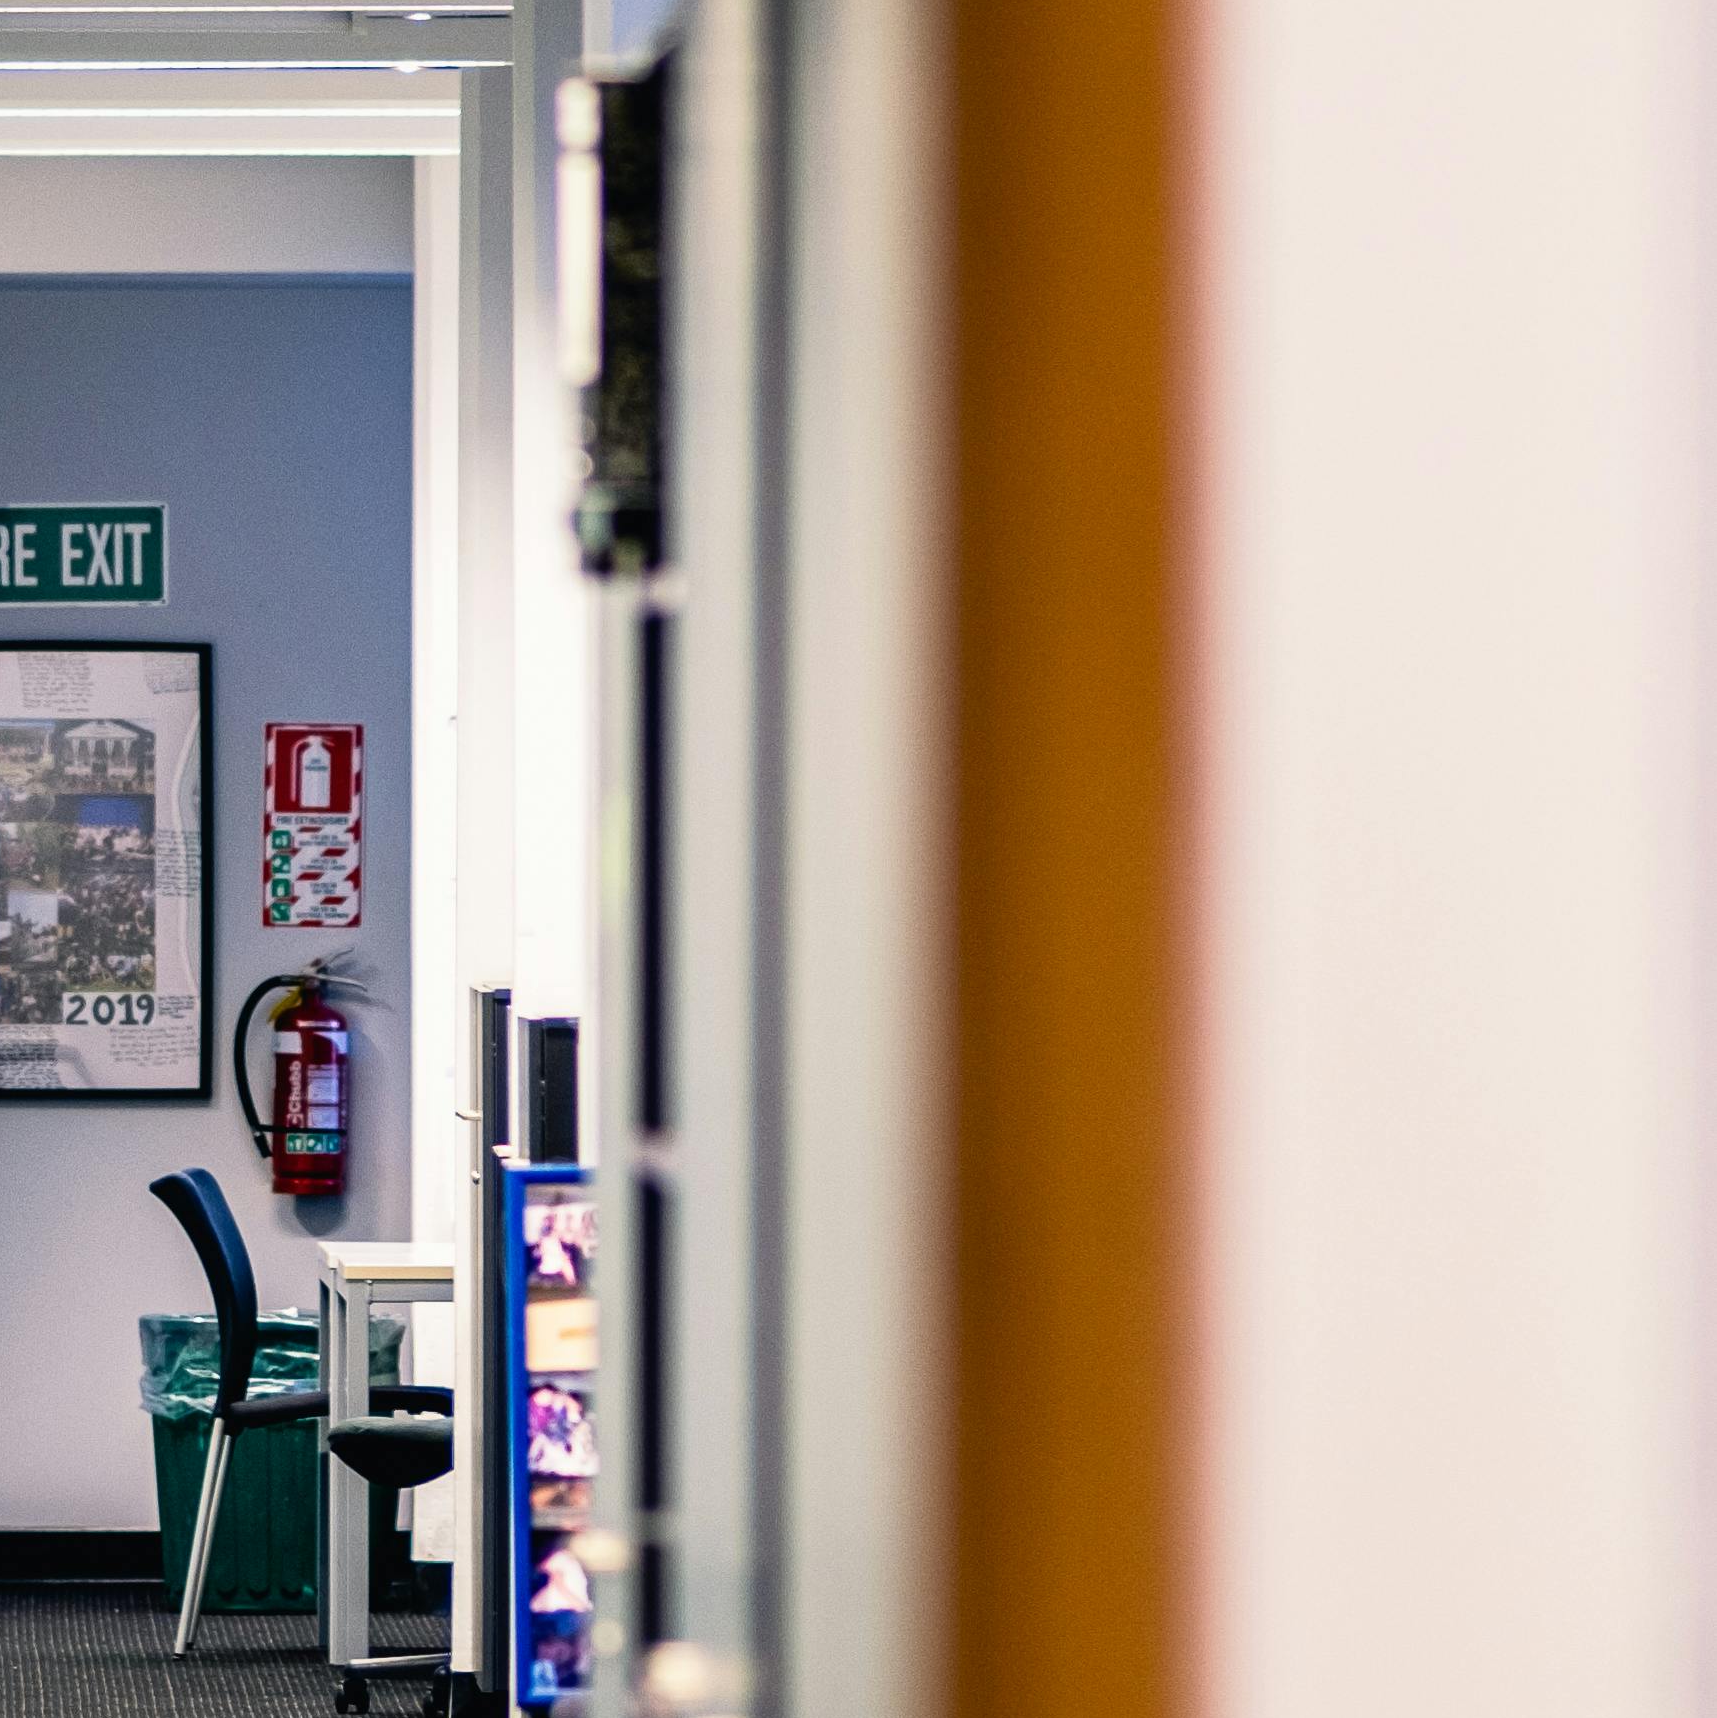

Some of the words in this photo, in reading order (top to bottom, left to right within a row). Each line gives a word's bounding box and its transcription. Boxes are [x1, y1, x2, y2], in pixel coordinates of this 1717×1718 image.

[61, 522, 152, 586] EXIT
[65, 993, 155, 1026] 2019
[288, 1060, 302, 1113] Chubb
